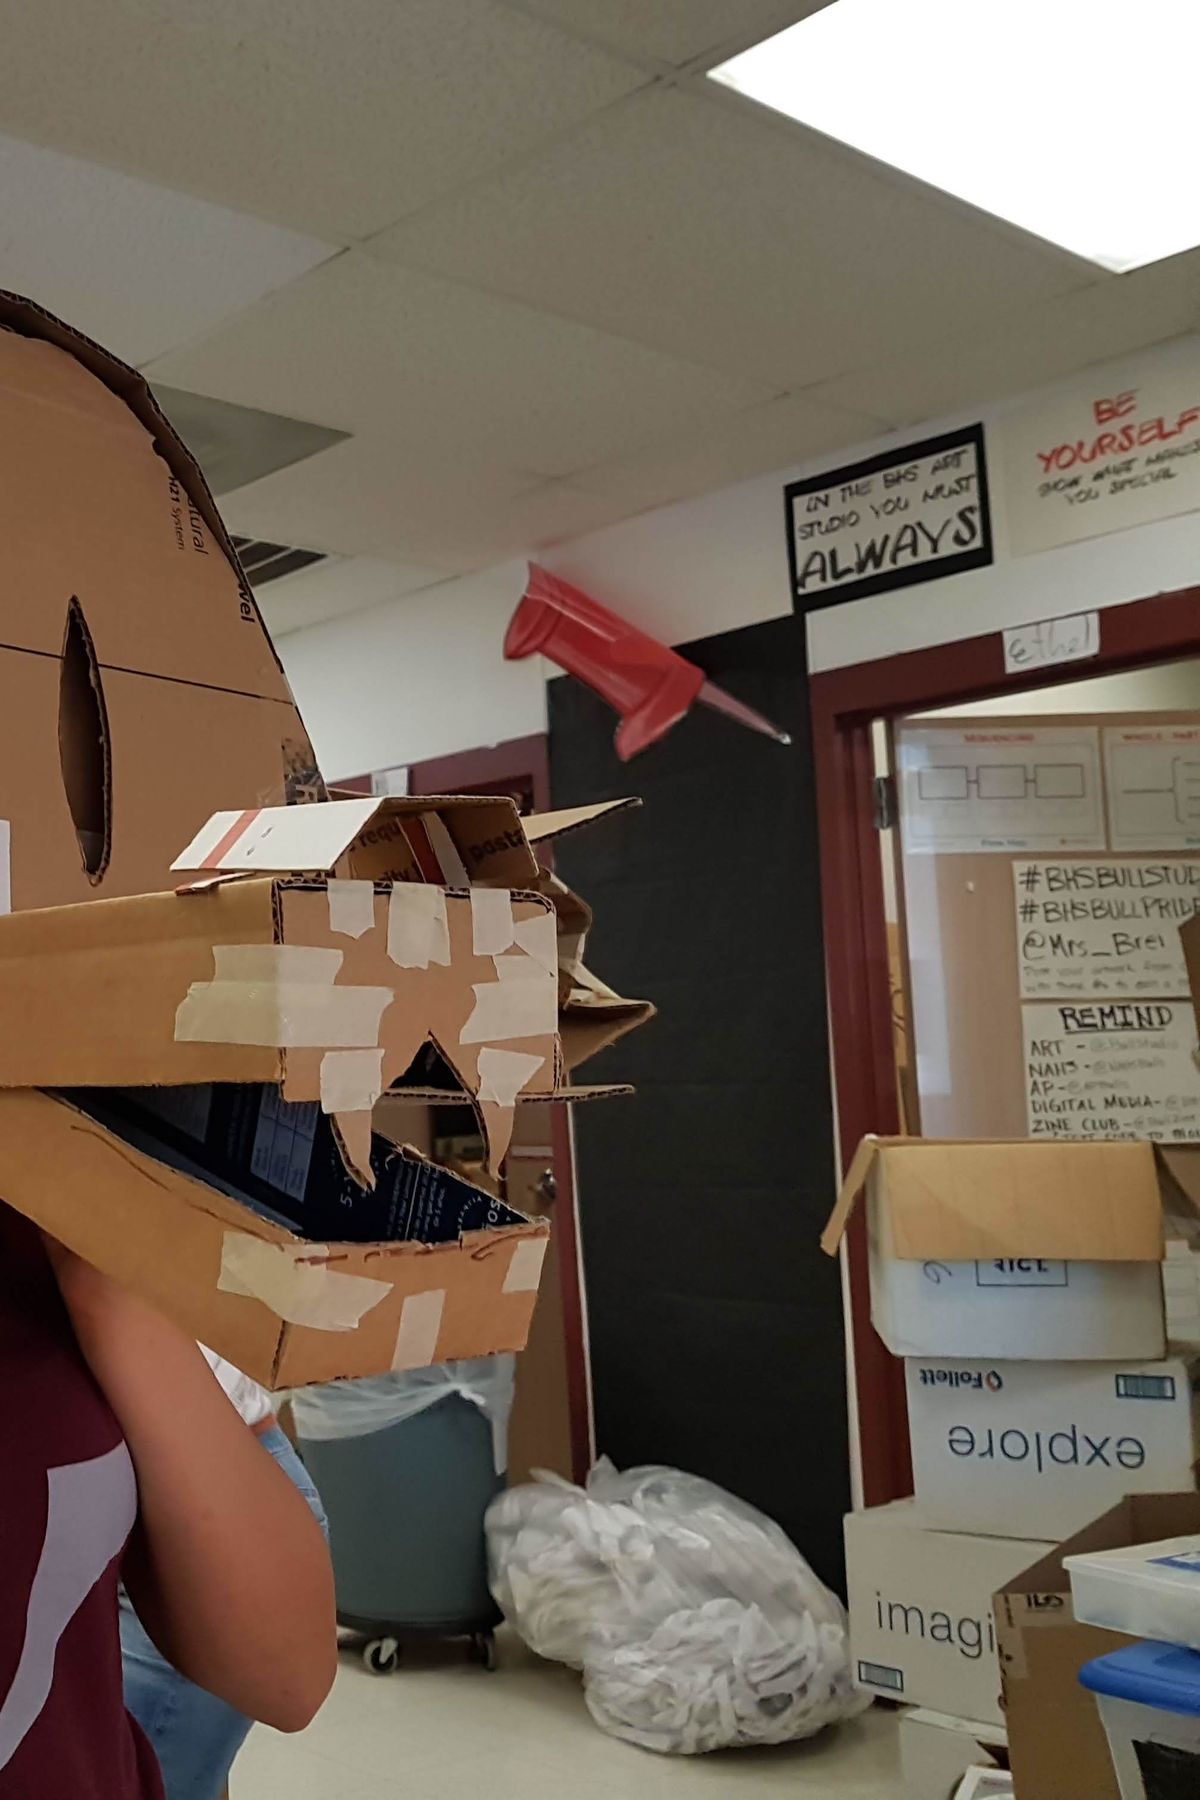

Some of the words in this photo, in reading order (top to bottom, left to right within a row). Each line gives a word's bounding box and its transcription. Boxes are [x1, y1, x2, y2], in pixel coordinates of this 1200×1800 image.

[1093, 388, 1141, 426] BE
[1036, 406, 1200, 474] YOURSELF
[805, 492, 830, 513] IN
[839, 482, 873, 503] THE
[883, 464, 920, 489] BHS
[930, 449, 968, 476] ART
[797, 510, 861, 541] STUDIO
[869, 494, 911, 520] YOU
[922, 475, 976, 503] MUST
[170, 505, 186, 551] System
[797, 505, 980, 590] ALWAYS
[237, 584, 256, 624] wel
[1018, 864, 1200, 893] #BHSBULLSTUD
[1058, 1005, 1173, 1030] REMIND
[1030, 1040, 1065, 1057] ART
[1029, 1060, 1079, 1079] NAHS
[1031, 1098, 1096, 1116] DIGITAL
[1031, 1117, 1072, 1134] ZINE
[1081, 1116, 1123, 1133] CLUB
[919, 1369, 982, 1389] Follett
[948, 1423, 1146, 1474] explore
[876, 1590, 996, 1659] imagi
